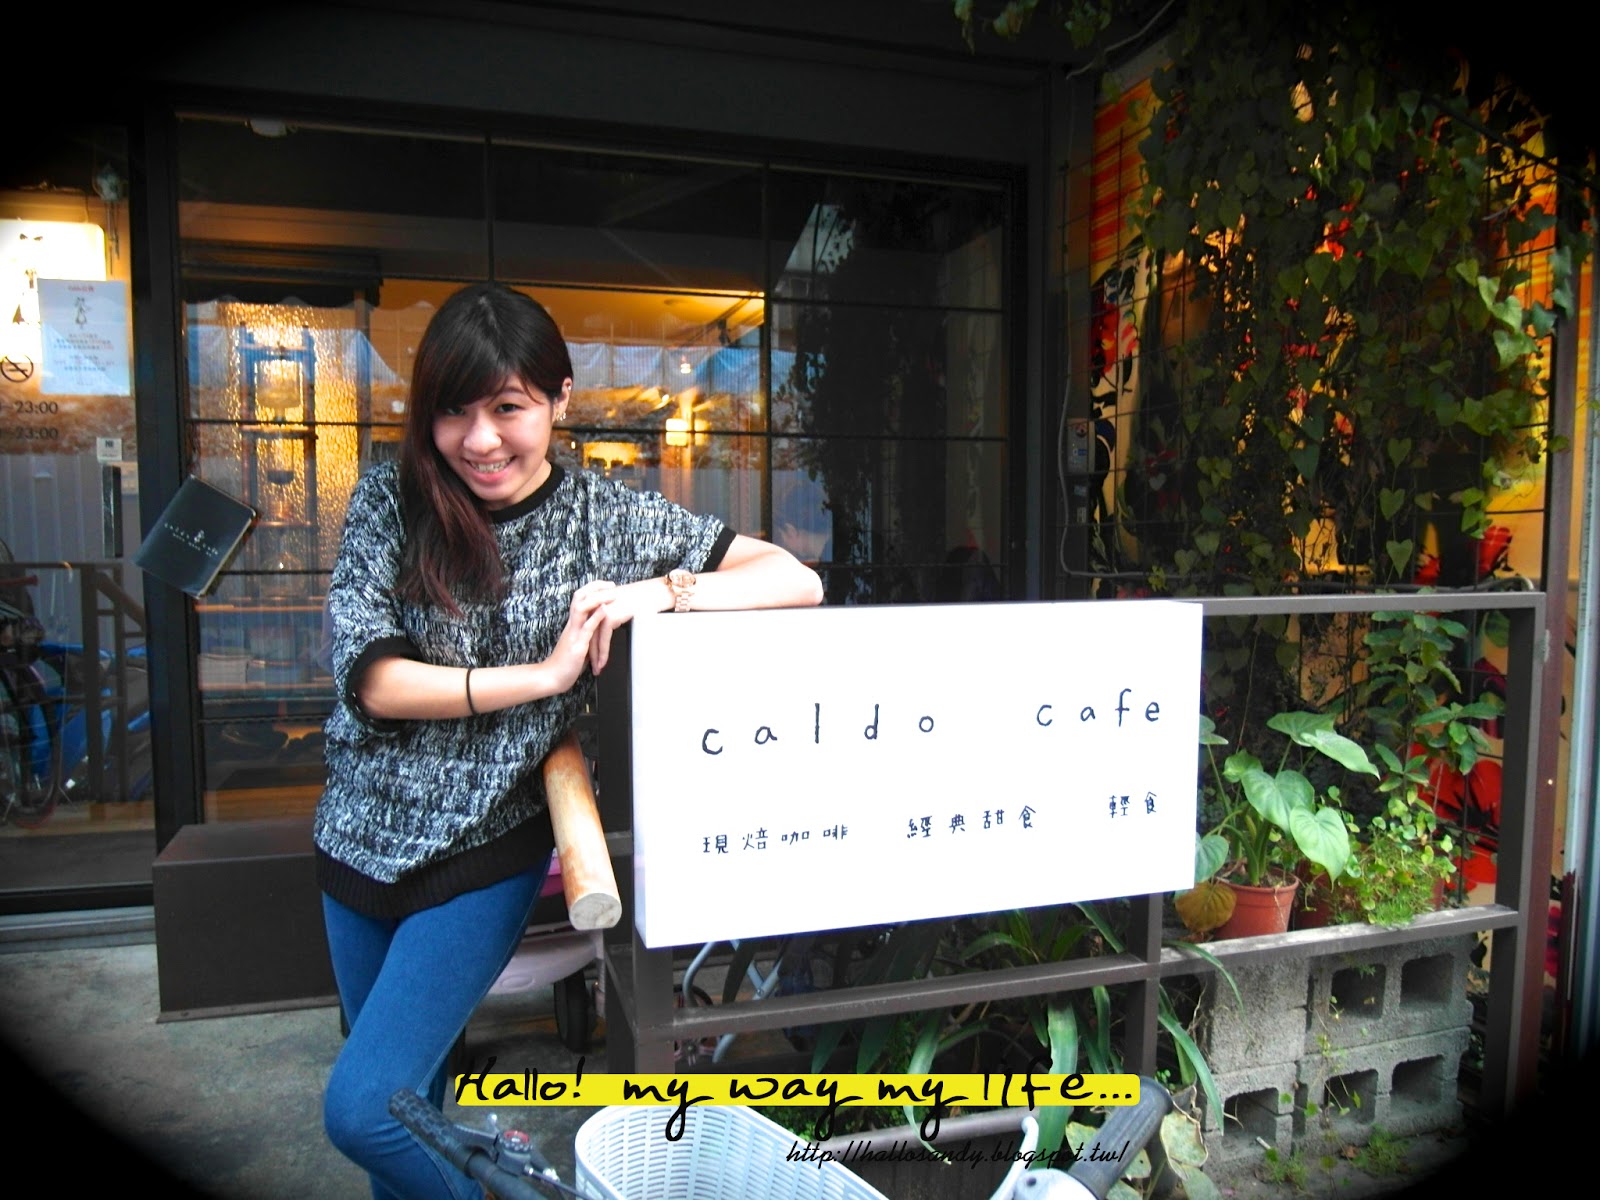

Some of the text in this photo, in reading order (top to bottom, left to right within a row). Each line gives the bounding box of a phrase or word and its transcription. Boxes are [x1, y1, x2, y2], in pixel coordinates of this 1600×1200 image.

[15, 401, 58, 414] 23:00
[15, 427, 58, 440] 23:00
[702, 688, 1160, 755] caldo cafe
[703, 791, 1157, 854] 現焙咖啡 經典甜食 輕食
